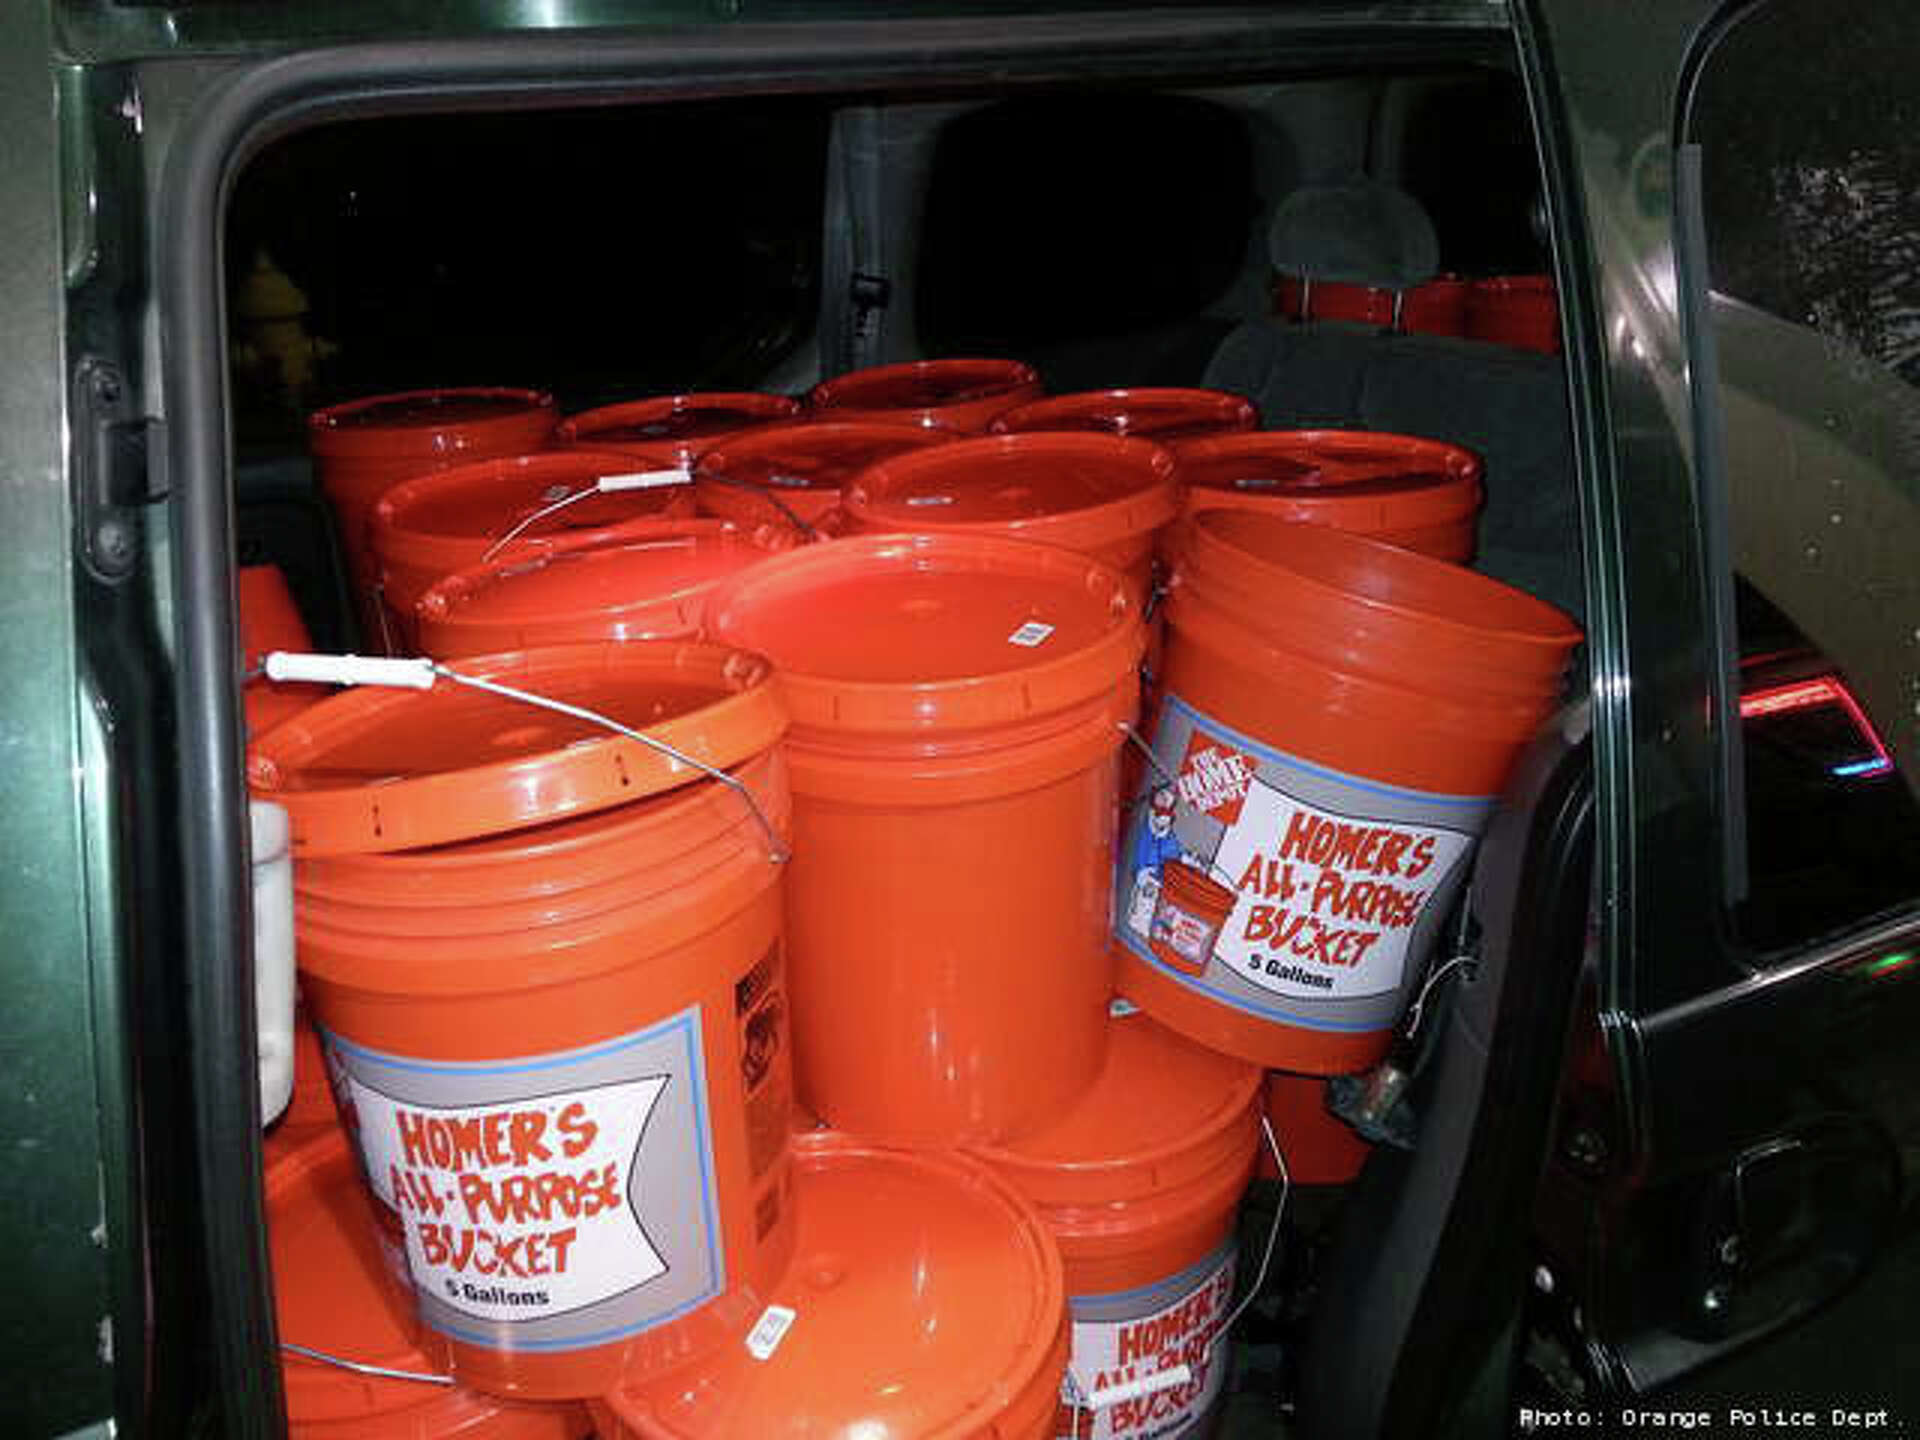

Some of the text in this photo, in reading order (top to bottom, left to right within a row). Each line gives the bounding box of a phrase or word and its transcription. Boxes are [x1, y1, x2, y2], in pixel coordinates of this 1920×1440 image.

[1279, 812, 1436, 878] HOMER'S
[1244, 905, 1380, 968] BUCKET
[1248, 954, 1335, 989] 5 Gallons
[396, 1102, 599, 1170] HOMER'S
[389, 1161, 622, 1226] ALL-PURPOSE
[418, 1221, 577, 1278] BUCKET
[445, 1280, 550, 1306] 5 Gallons
